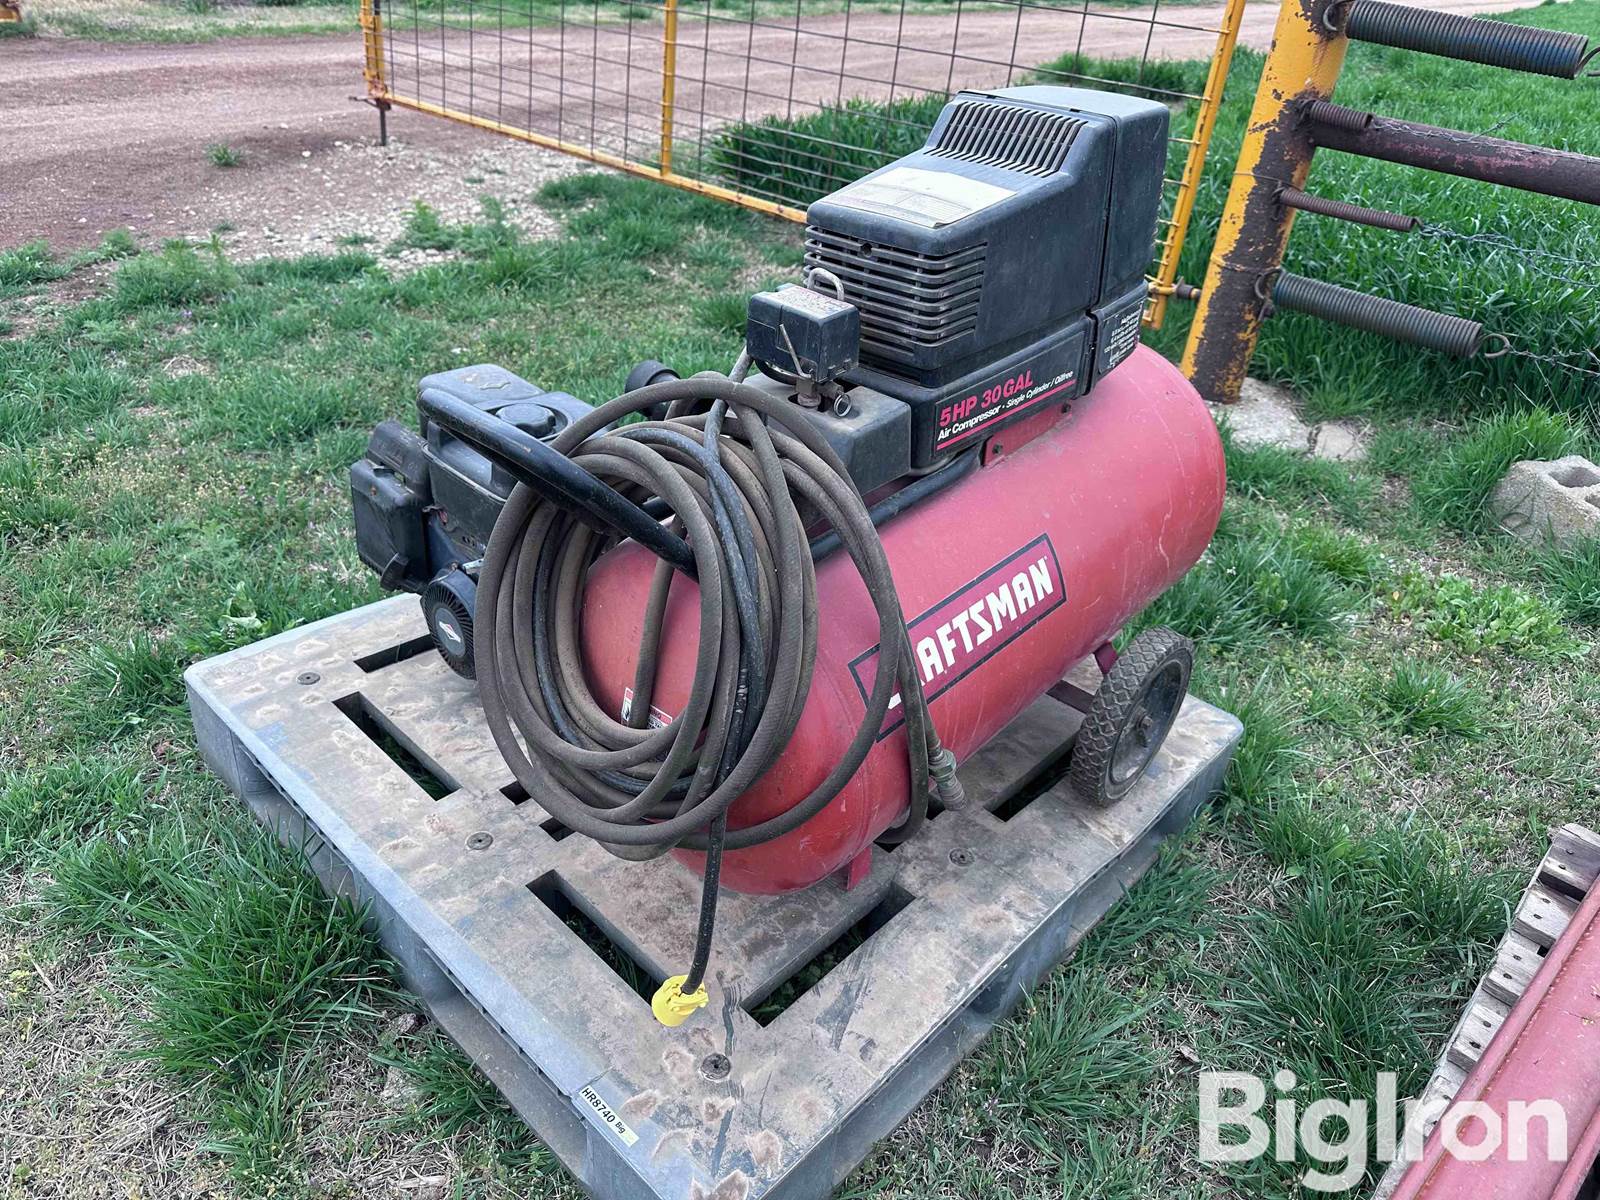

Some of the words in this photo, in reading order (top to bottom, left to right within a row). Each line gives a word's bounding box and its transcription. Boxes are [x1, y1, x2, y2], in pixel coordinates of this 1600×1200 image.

[937, 428, 951, 441] Air
[951, 405, 1001, 434] Compressor
[1006, 393, 1025, 408] Single
[1026, 382, 1051, 399] Cylinder
[886, 557, 1054, 710] AFTSMAN
[582, 1088, 616, 1123] HR8740
